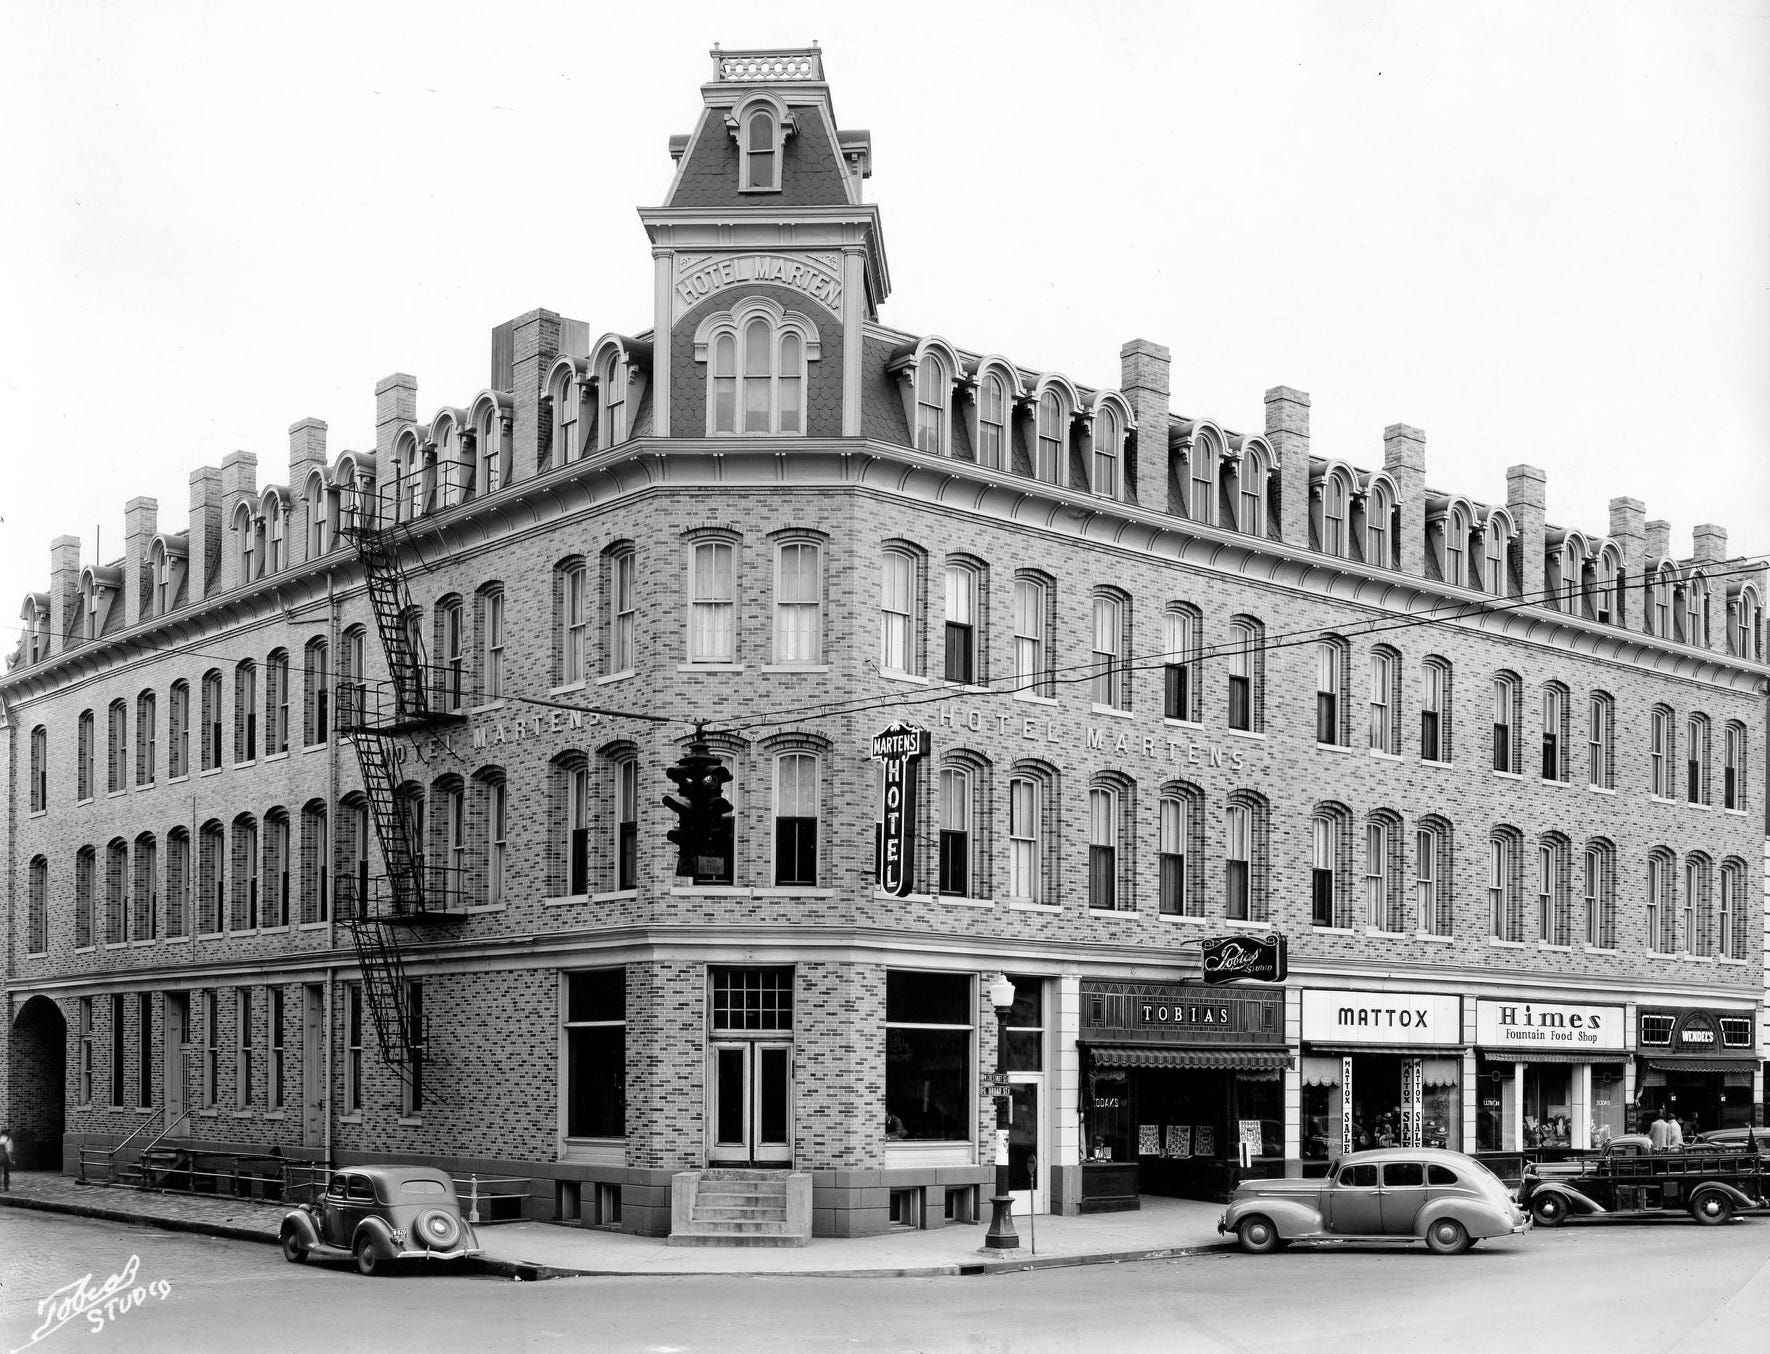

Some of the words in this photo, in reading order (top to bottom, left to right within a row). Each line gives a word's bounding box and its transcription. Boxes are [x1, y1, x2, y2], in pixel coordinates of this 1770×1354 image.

[676, 259, 749, 304] HOTEL
[939, 705, 1059, 743] HOTEL
[873, 734, 917, 754] MARTENS
[886, 759, 900, 888] HOTEL
[1245, 964, 1273, 973] STUDIO
[1143, 1006, 1228, 1023] TOBIAS
[1338, 1007, 1428, 1028] MATTOX
[1498, 1004, 1601, 1029] Himes
[1506, 1028, 1545, 1040] Fountain
[1551, 1030, 1573, 1041] Food
[1578, 1030, 1598, 1044] Shop
[1682, 1030, 1714, 1042] WENDEL'S
[1343, 1061, 1351, 1104] MATTOX
[1402, 1061, 1411, 1104] MATTOX
[1094, 1097, 1119, 1108] ODAKS
[1343, 1112, 1351, 1154] SALE
